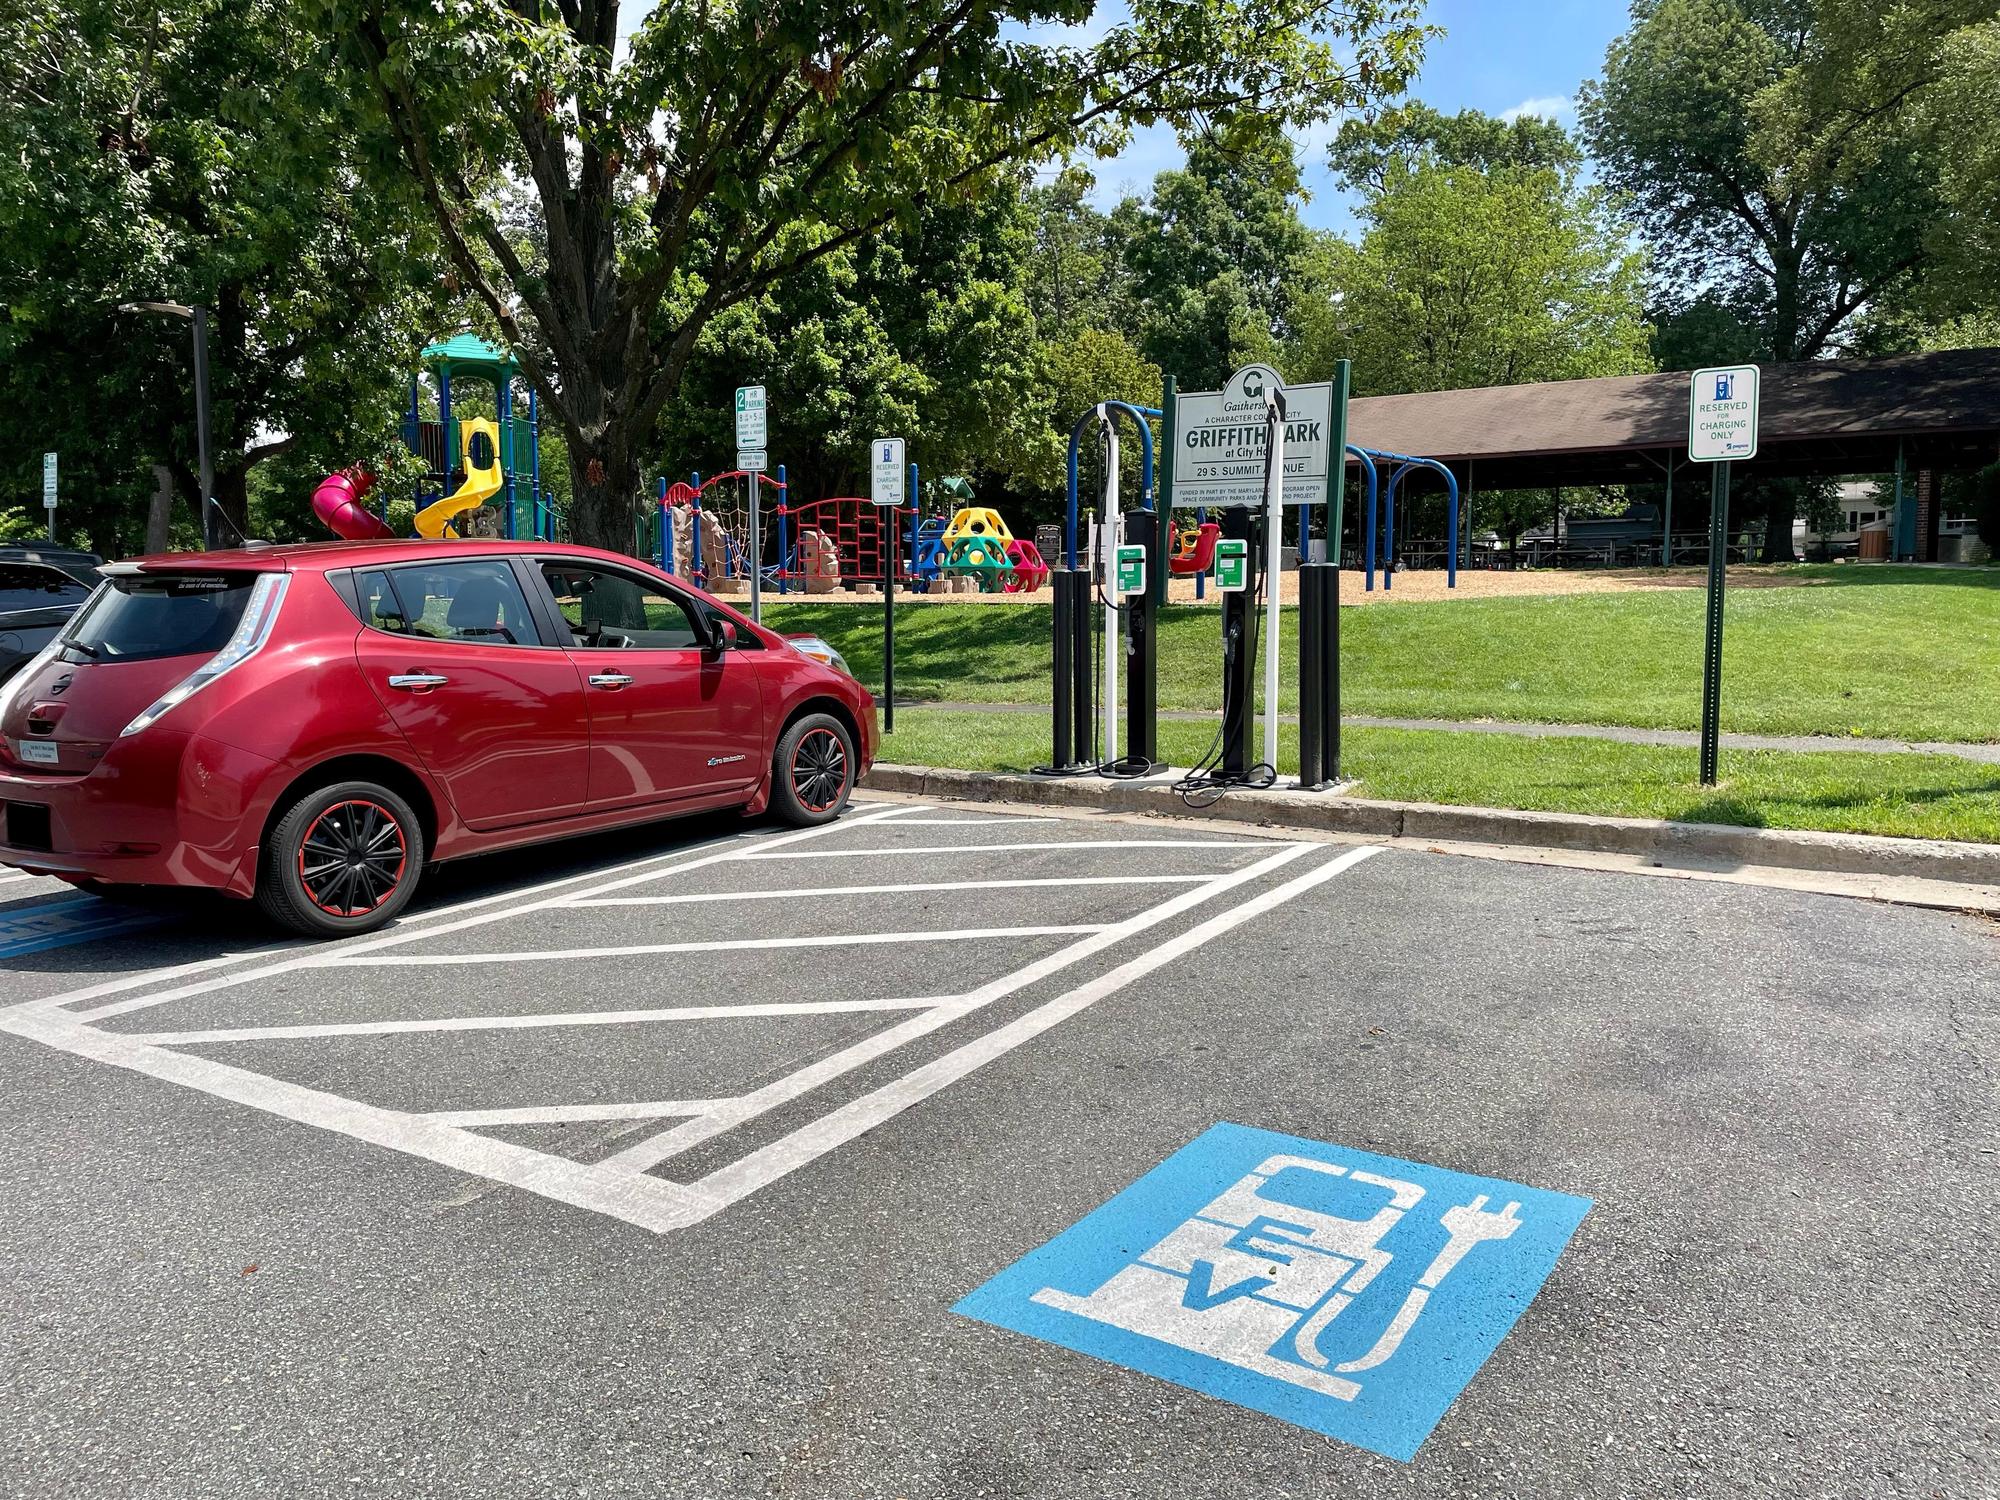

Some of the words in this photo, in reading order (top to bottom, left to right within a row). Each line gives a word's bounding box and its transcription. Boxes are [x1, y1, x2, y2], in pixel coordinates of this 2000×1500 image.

[738, 393, 745, 408] 2
[750, 390, 757, 398] HR
[746, 400, 763, 408] PARKING
[1224, 401, 1267, 412] Gaithersb
[1700, 402, 1747, 412] RESERVED
[1211, 414, 1252, 423] CHARACTER
[1700, 420, 1746, 430] CHARGING
[1186, 426, 1267, 448] GRIFFITH
[1283, 422, 1321, 443] ARK
[1711, 431, 1734, 440] ONLY
[1225, 449, 1234, 458] at
[1237, 447, 1253, 458] City
[1256, 447, 1267, 456] Ha
[1197, 468, 1207, 477] 29
[1210, 467, 1219, 476] S.
[1222, 465, 1261, 475] SUMMIT
